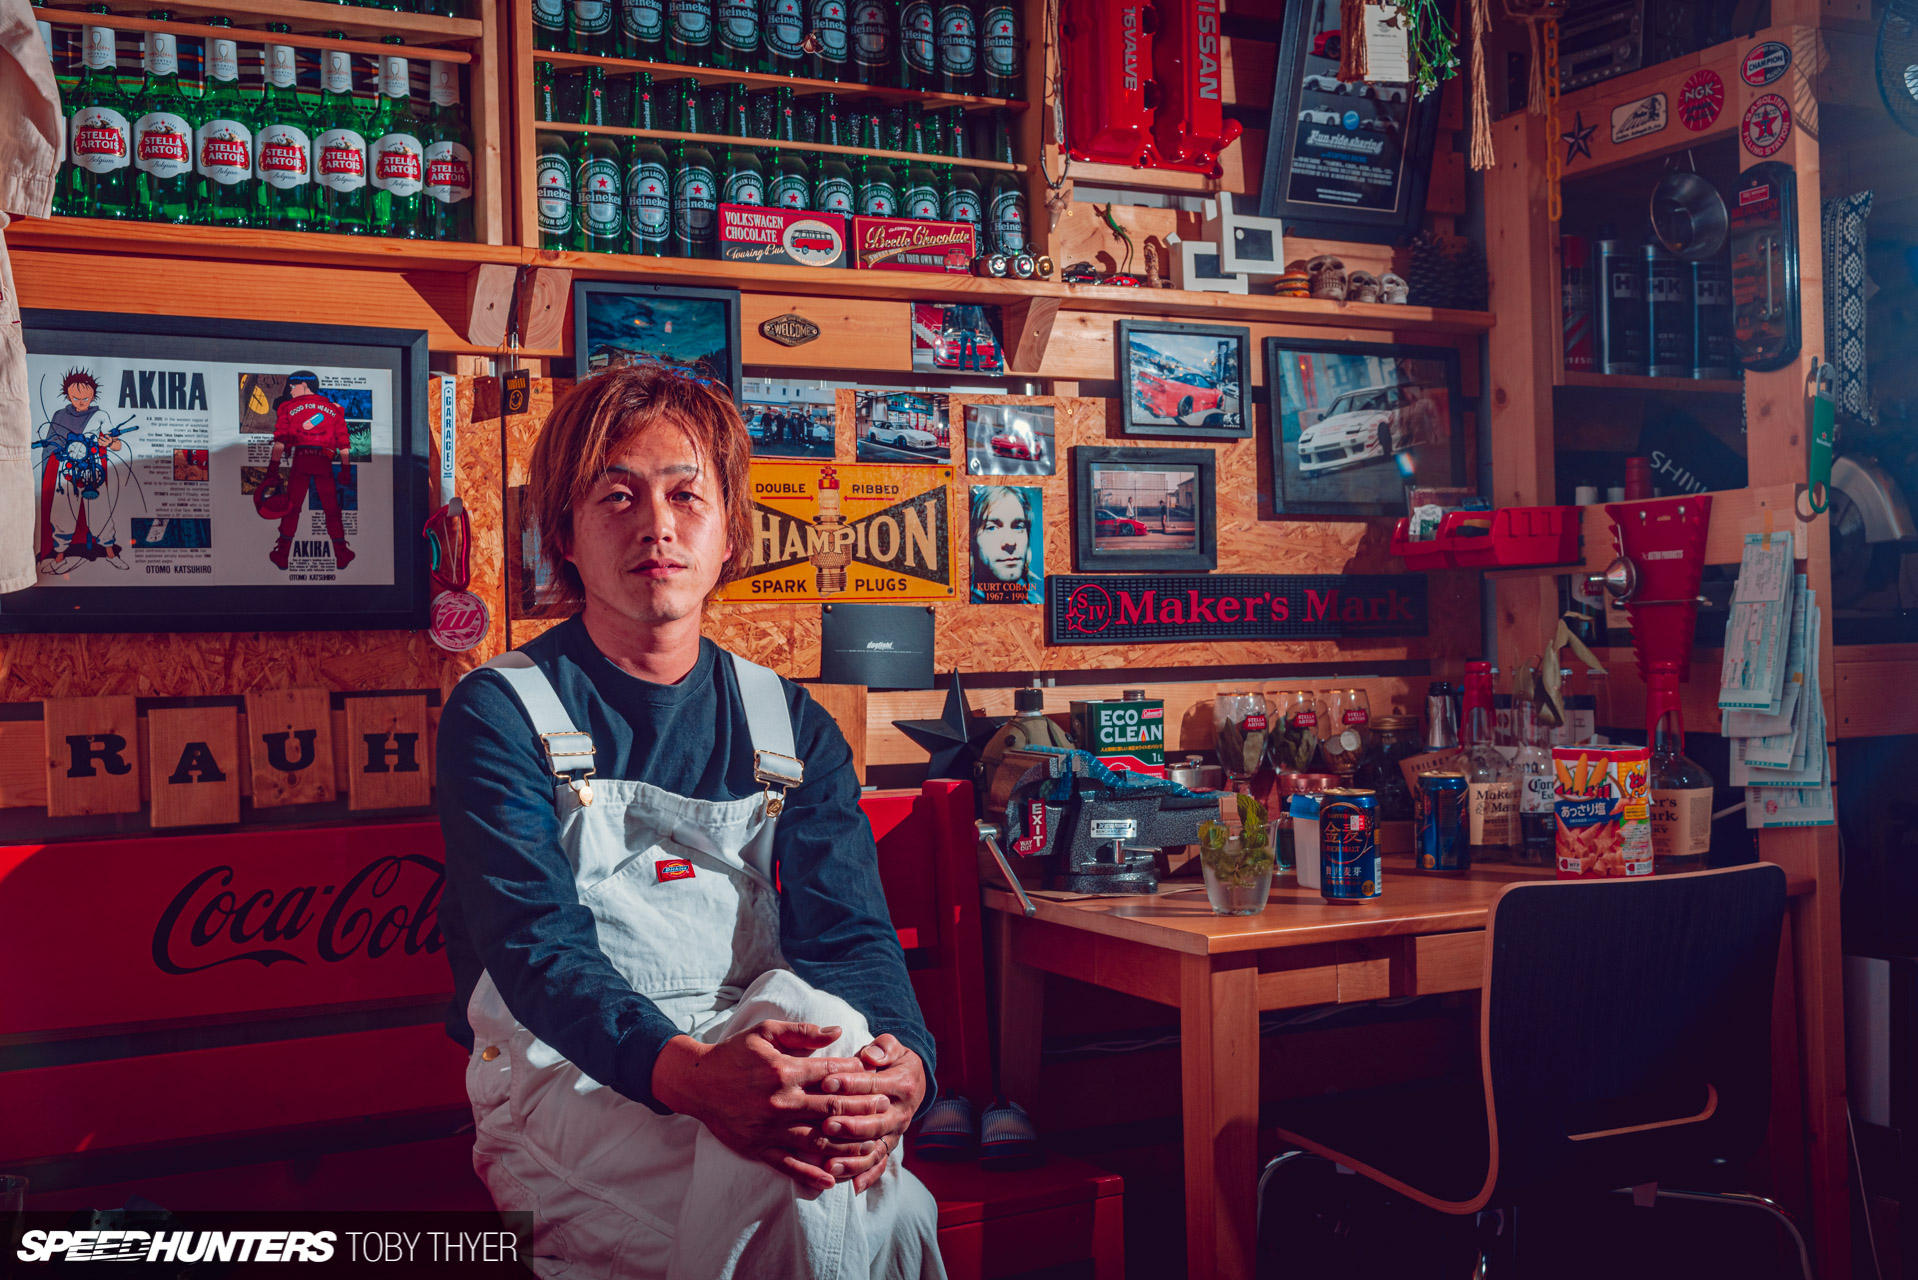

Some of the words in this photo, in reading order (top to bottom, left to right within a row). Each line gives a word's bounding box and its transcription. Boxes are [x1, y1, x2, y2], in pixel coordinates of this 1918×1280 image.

[669, 3, 712, 17] Heineken
[718, 7, 759, 22] Heineken
[767, 15, 803, 28] Heineke
[1748, 54, 1783, 72] CHAMPION
[1684, 81, 1715, 103] NGK
[81, 131, 119, 142] STELLA
[145, 136, 182, 147] STELLA
[81, 140, 120, 150] ARTOIS
[145, 145, 183, 156] ARTOIS
[208, 143, 245, 155] STELLA
[208, 152, 245, 163] ARTOIS
[265, 148, 301, 160] STELLA
[325, 151, 360, 162] STELLA
[265, 157, 302, 168] ARTOIS
[325, 160, 361, 171] ARTOIS
[383, 156, 417, 167] STELLA
[383, 165, 418, 176] ARTOIS
[431, 164, 465, 175] STELLA
[431, 173, 465, 183] ARTOIS
[537, 187, 572, 200] eineken
[578, 192, 622, 205] Heineken
[629, 196, 669, 208] Heineken
[674, 200, 717, 211] Heineken
[725, 211, 784, 229] VOLKSWAGEN
[726, 226, 777, 243] CHOCOLATE
[864, 225, 911, 249] Beetle
[912, 225, 970, 247] Chocolate
[906, 255, 919, 264] YOUR
[920, 255, 932, 265] OWN
[774, 322, 811, 338] WELCOME
[118, 369, 208, 411] AKIRA
[289, 404, 304, 416] GOOD
[755, 483, 806, 494] DOUBLE
[852, 484, 900, 495] RIBBED
[751, 499, 938, 572] HAMPION
[293, 540, 331, 558] AKIRA
[146, 565, 171, 574] OTOMO
[174, 565, 212, 574] KATSUHIRO
[751, 579, 807, 594] SPARK
[855, 578, 908, 592] PLUGS
[977, 582, 1001, 591] KURT
[1003, 582, 1037, 591] COBAIN
[986, 592, 1004, 601] 1967
[1012, 592, 1029, 600] 1994
[1114, 588, 1290, 627] Maker's
[1302, 588, 1415, 623] Mark
[1100, 709, 1139, 726] ECO
[1100, 724, 1163, 743] CLEAN
[1152, 752, 1163, 763] 1L
[1561, 802, 1606, 818] あっさり塩
[1031, 802, 1044, 847] EXIT
[1323, 821, 1363, 844] 金麦
[1341, 845, 1361, 853] MALT
